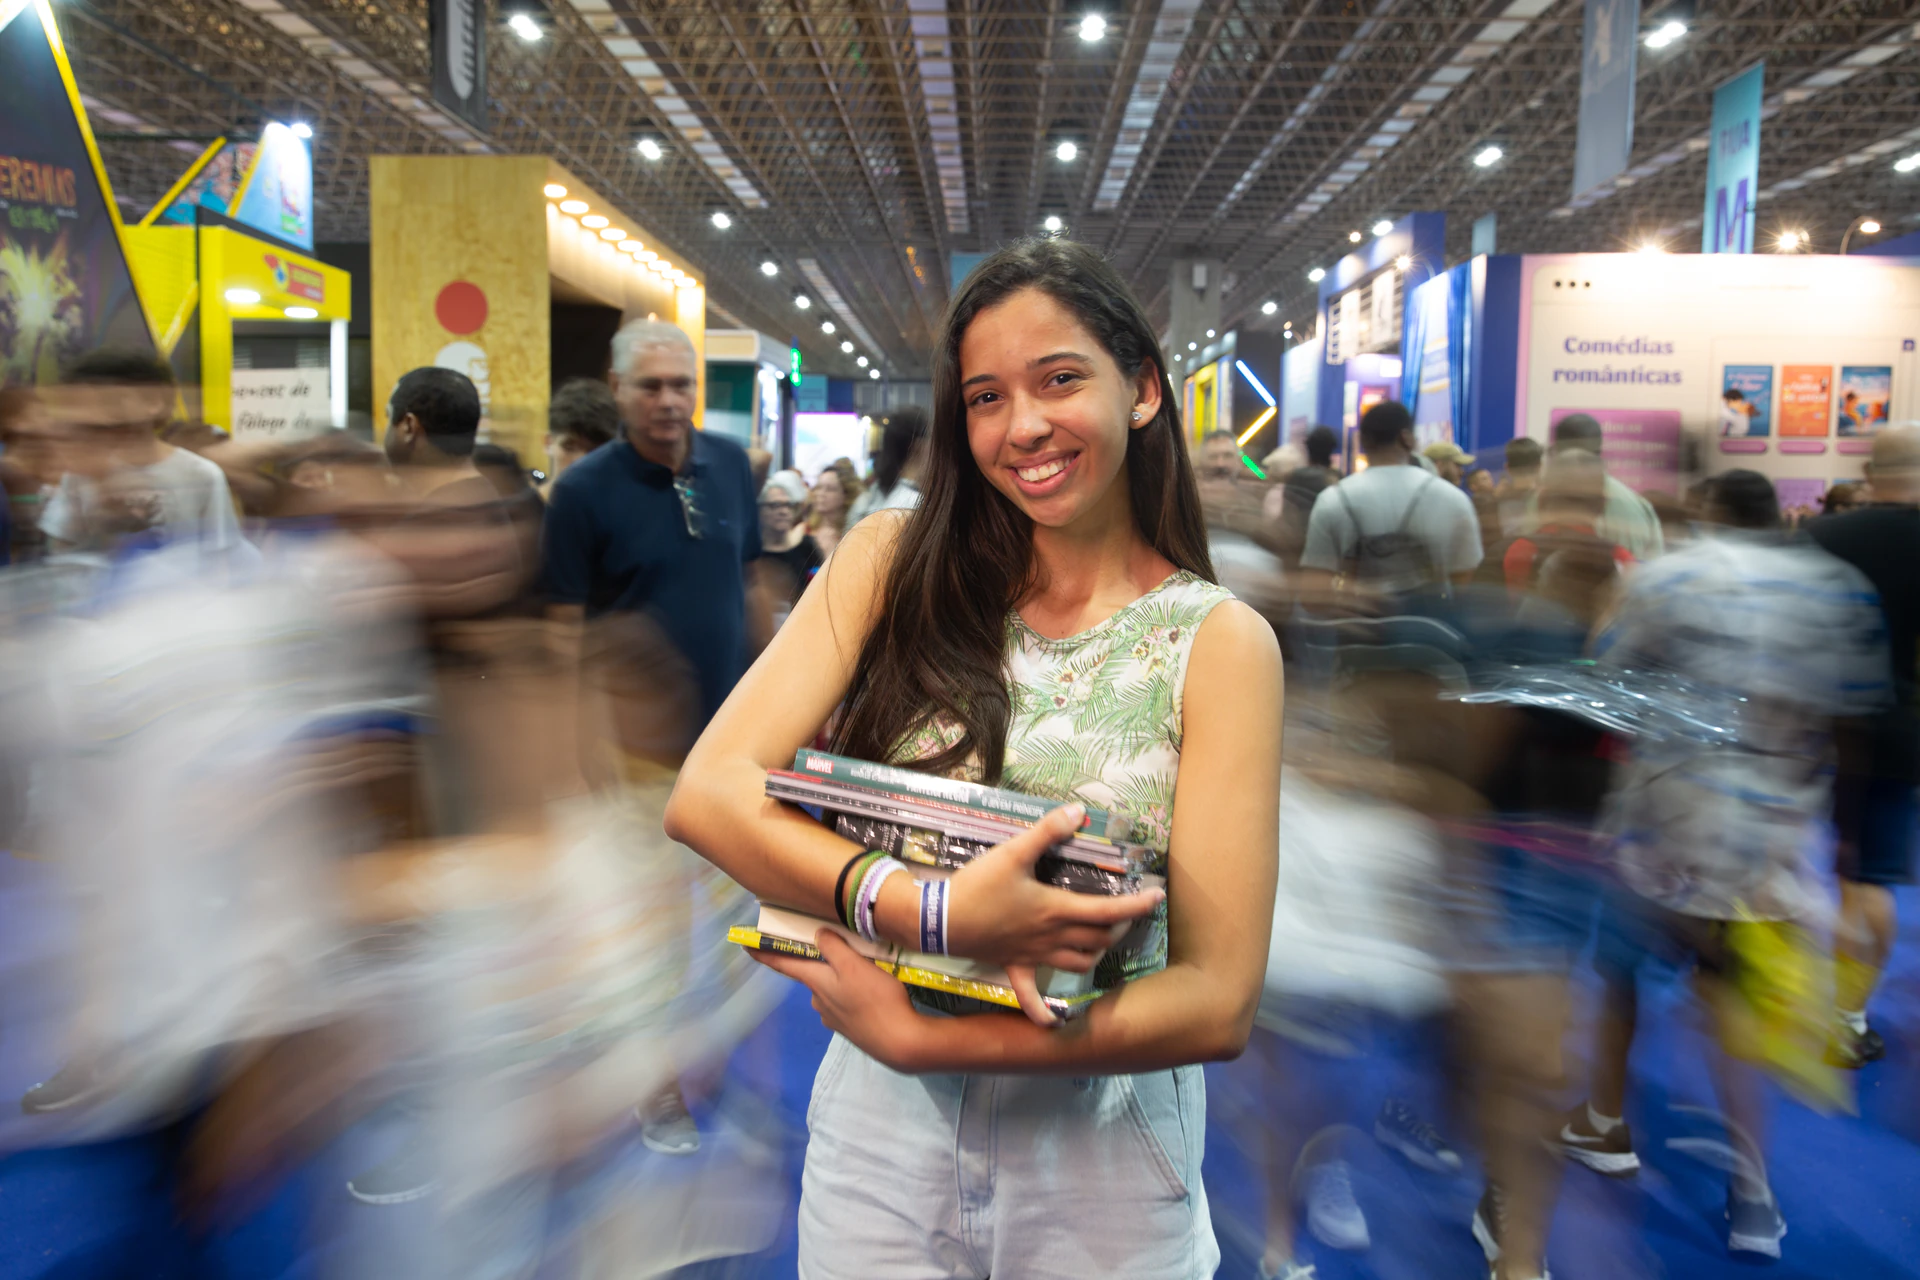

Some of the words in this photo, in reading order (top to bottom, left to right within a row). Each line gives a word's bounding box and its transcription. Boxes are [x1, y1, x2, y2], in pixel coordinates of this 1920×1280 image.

[1563, 336, 1674, 354] Comédias
[1553, 364, 1682, 384] românticas
[807, 756, 834, 775] MARVEL
[773, 938, 805, 956] CYBERPUNK
